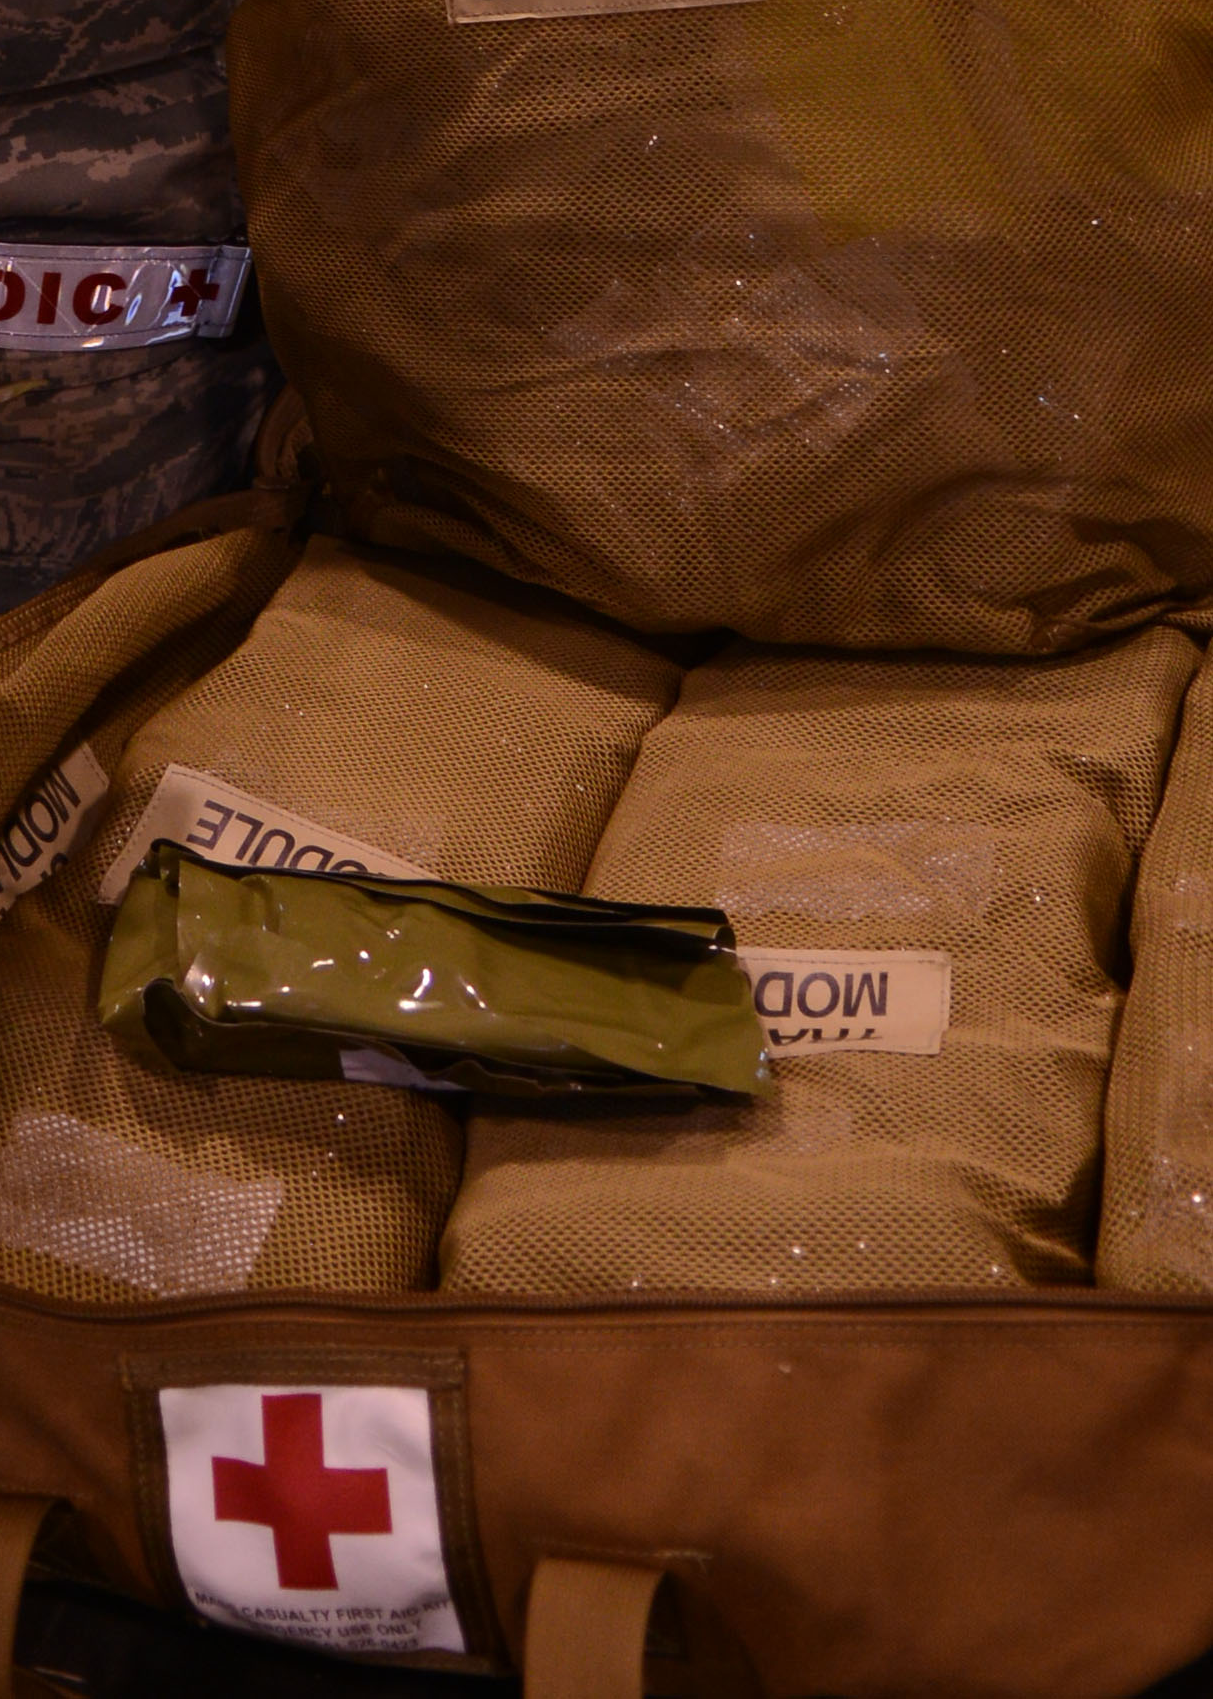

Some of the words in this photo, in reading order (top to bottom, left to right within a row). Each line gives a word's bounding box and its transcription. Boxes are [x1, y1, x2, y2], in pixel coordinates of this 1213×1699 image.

[186, 800, 394, 878] DULE
[241, 1606, 330, 1623] CASUALTY
[336, 1607, 383, 1622] FIRST
[336, 1624, 371, 1638] USE
[377, 1617, 421, 1636] ONLY
